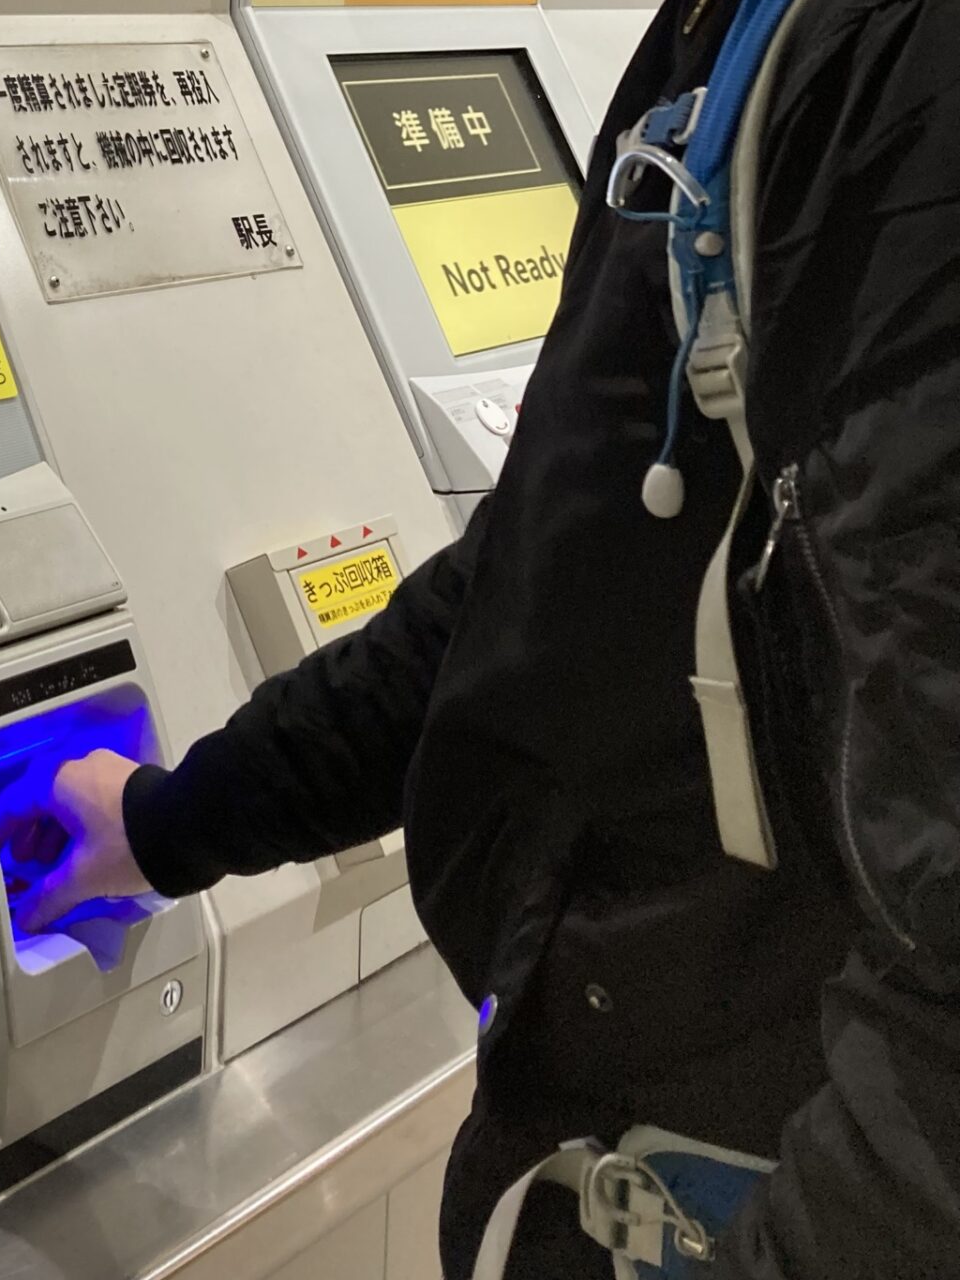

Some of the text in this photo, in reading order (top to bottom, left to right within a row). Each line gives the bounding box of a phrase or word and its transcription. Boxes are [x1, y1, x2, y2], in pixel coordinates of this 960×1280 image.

[392, 105, 492, 152] 準備中
[231, 213, 278, 249] 駅長
[441, 245, 566, 297] Not Ready
[303, 554, 392, 604] きっぷ回収箱
